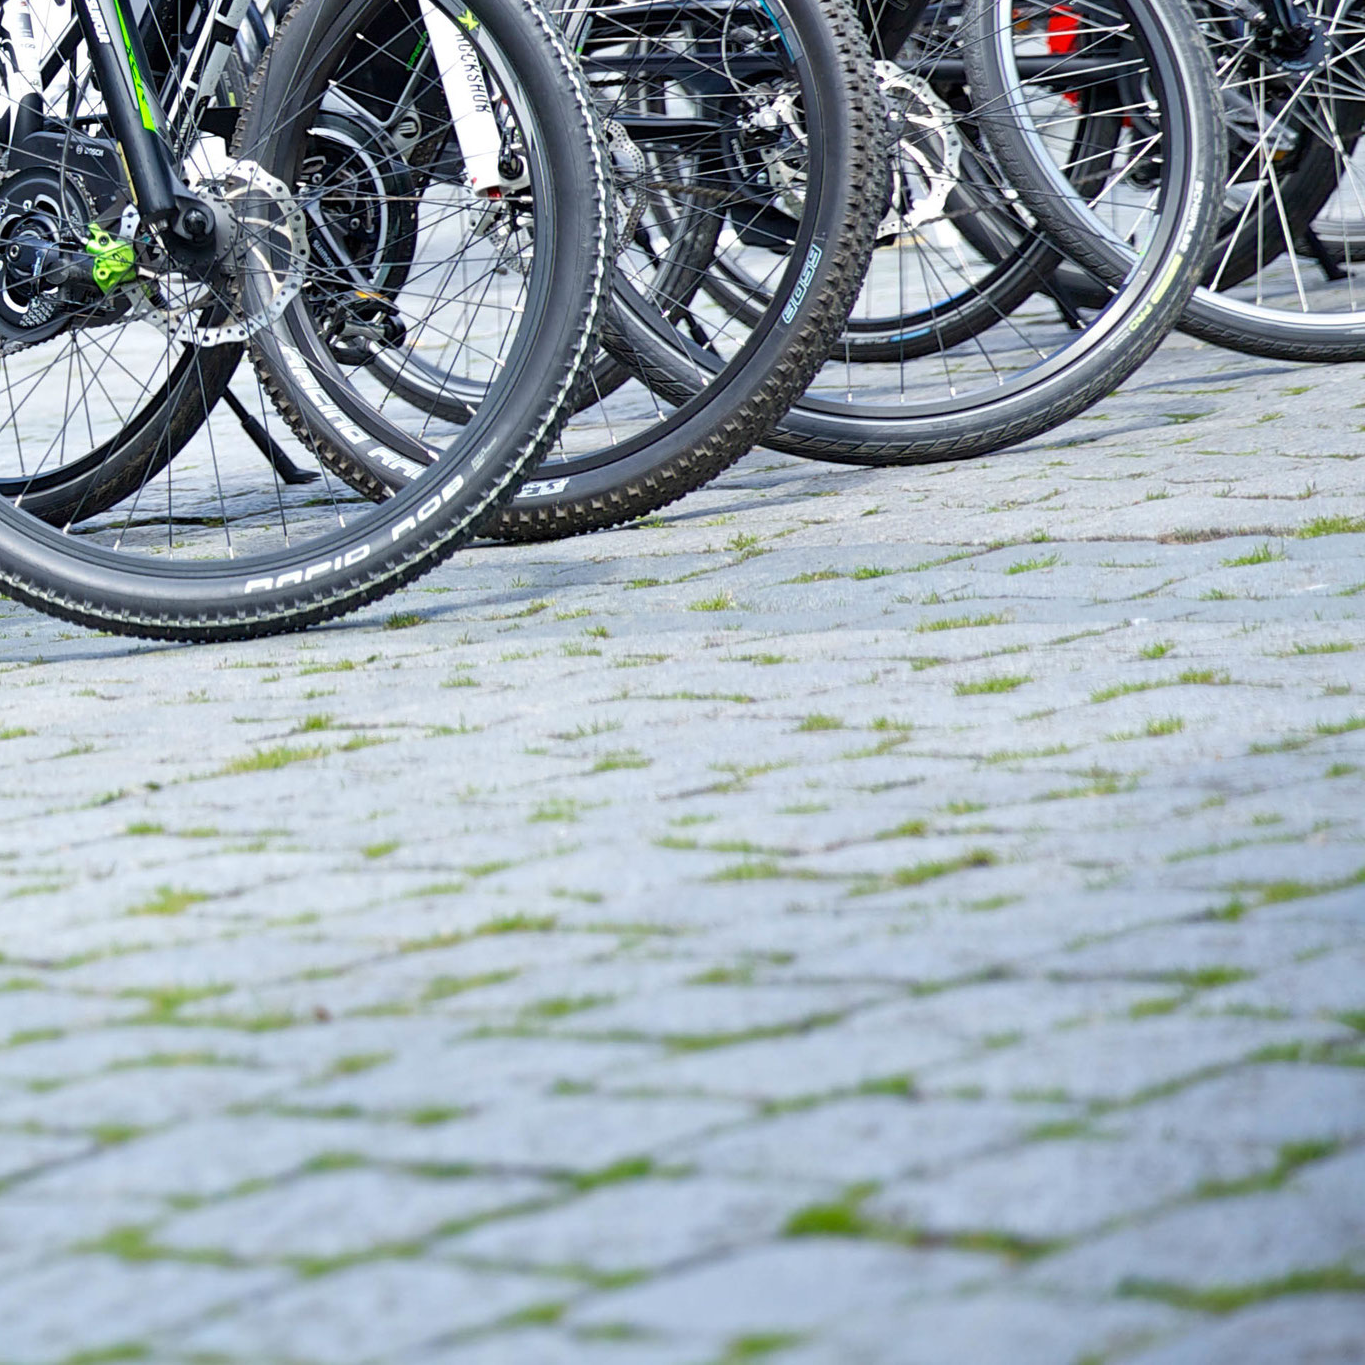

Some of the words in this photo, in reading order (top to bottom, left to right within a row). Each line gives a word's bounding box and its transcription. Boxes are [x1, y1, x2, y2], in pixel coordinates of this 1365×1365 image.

[1127, 301, 1154, 332] PRO
[244, 543, 370, 594] RAPID
[392, 473, 465, 541] ROB
